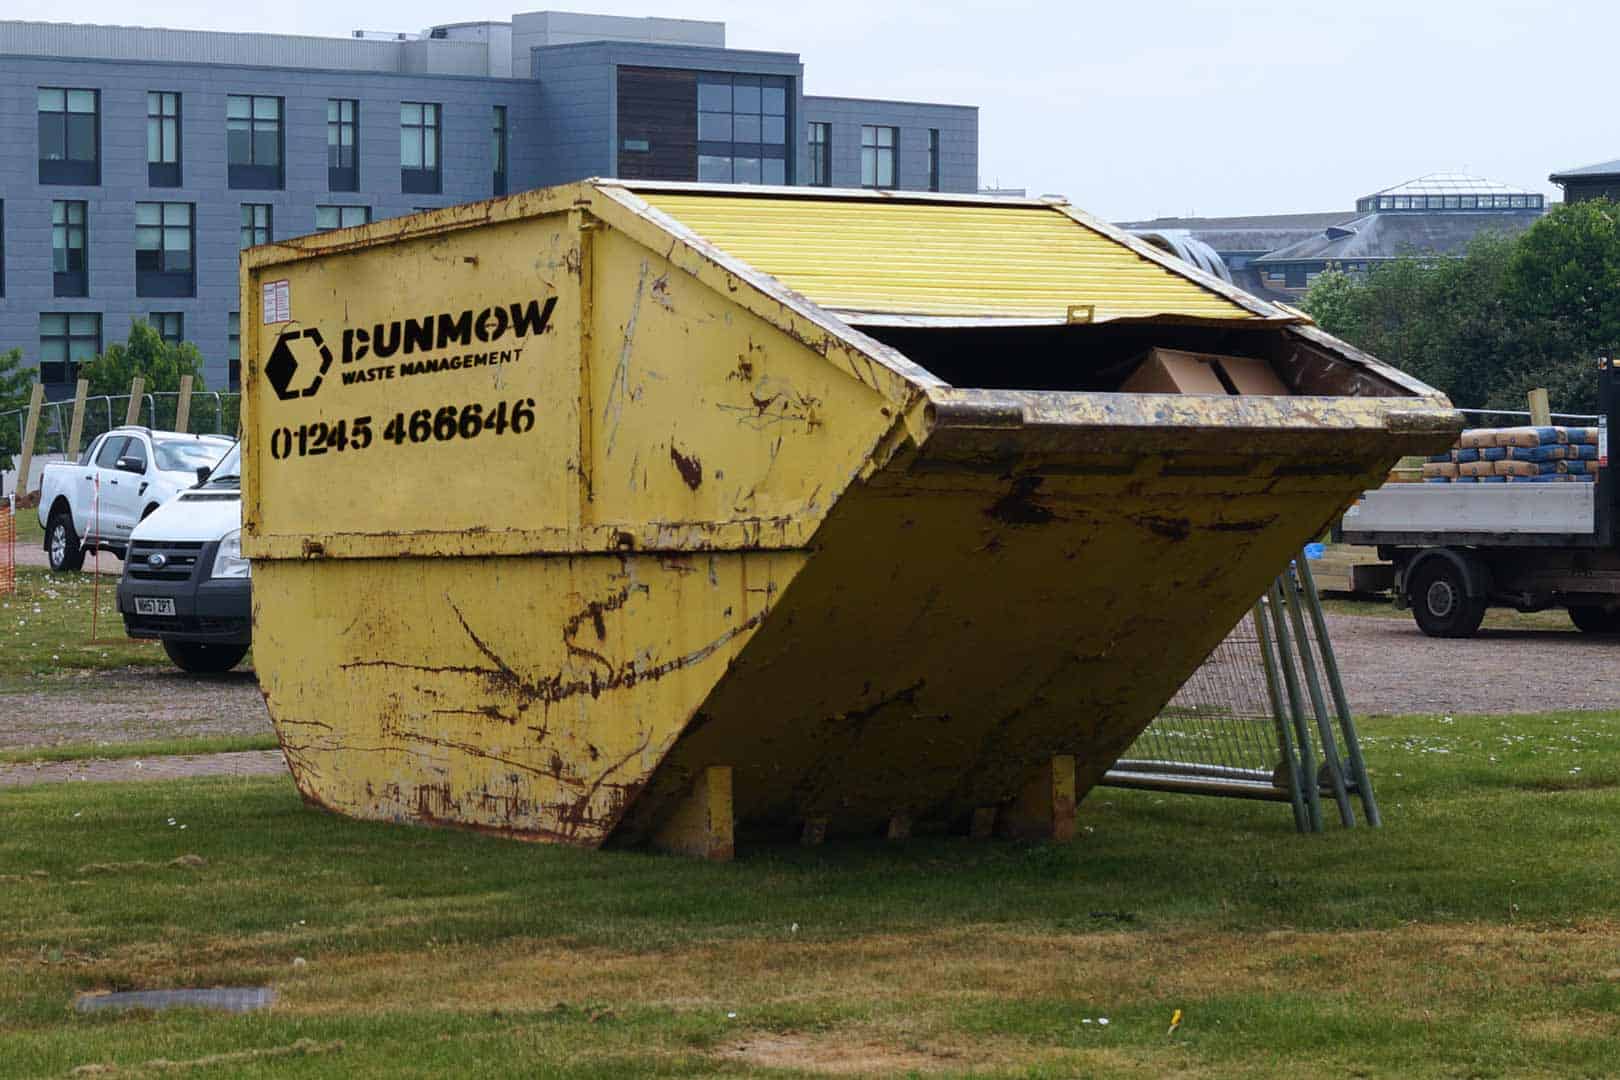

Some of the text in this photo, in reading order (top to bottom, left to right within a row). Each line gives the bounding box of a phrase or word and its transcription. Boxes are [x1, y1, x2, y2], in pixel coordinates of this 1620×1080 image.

[342, 296, 558, 363] DUNMOW
[342, 348, 522, 385] WASTE MANAGEMENT
[270, 398, 536, 460] 01245 466646
